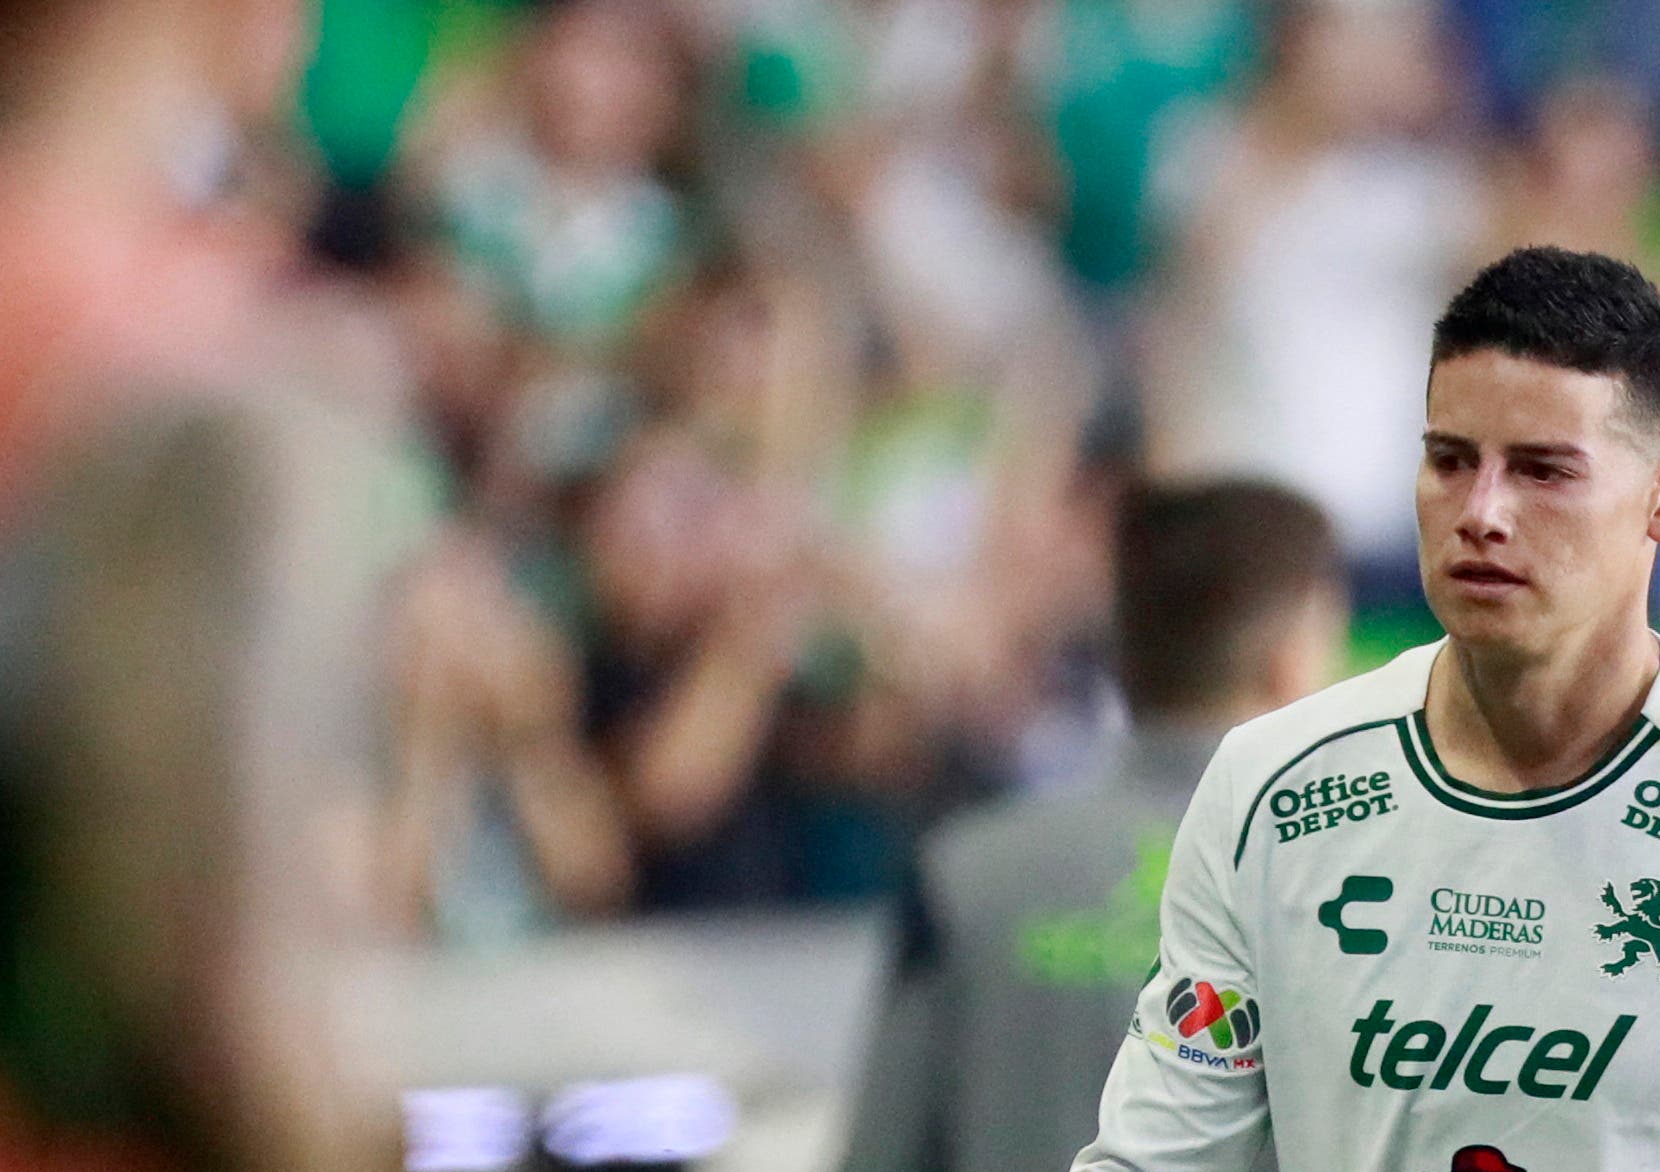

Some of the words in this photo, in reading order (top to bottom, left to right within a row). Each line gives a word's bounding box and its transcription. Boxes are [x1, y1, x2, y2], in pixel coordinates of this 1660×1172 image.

[1270, 771, 1391, 818] Office
[1275, 792, 1394, 844] DEPOT
[1428, 913, 1544, 945] MADERAS
[1427, 940, 1487, 955] TERRENOS
[1489, 945, 1542, 960] PREMIUM
[1177, 1043, 1229, 1070] BBVA
[1232, 1057, 1256, 1069] MX
[1348, 998, 1639, 1102] telcel
